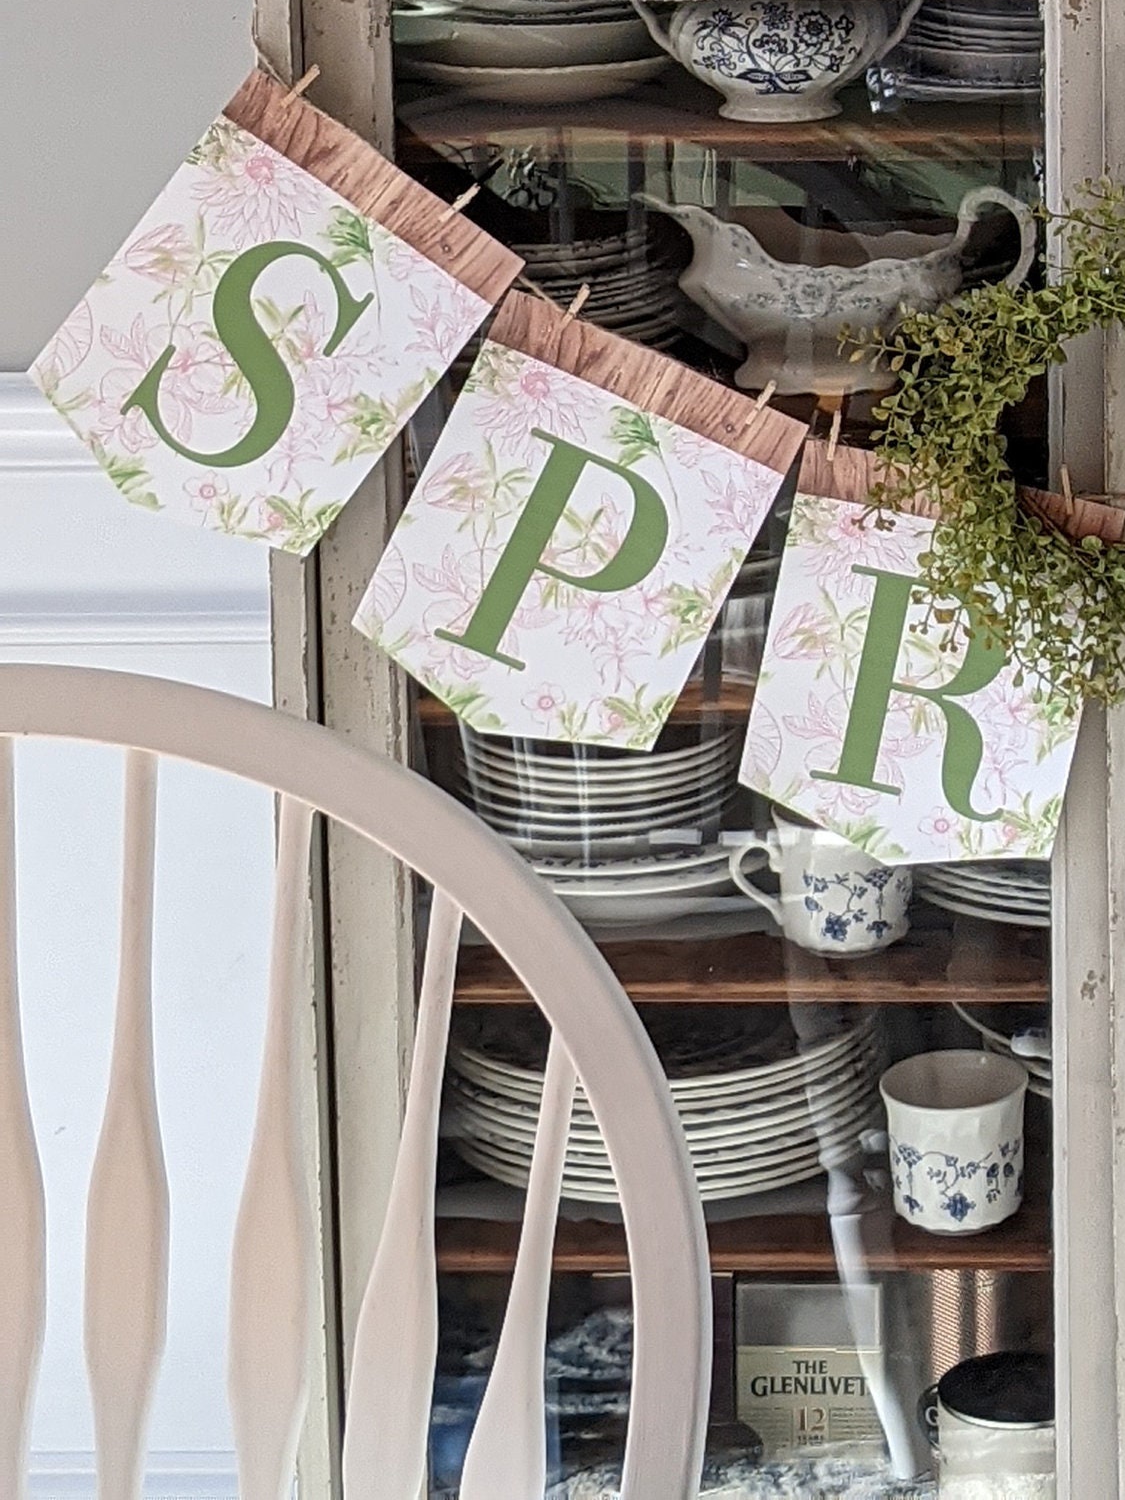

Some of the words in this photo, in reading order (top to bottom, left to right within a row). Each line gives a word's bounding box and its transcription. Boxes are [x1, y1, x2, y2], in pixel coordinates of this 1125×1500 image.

[792, 1359, 829, 1375] THE
[750, 1375, 868, 1398] GLENLIVET
[798, 1406, 826, 1432] 12
